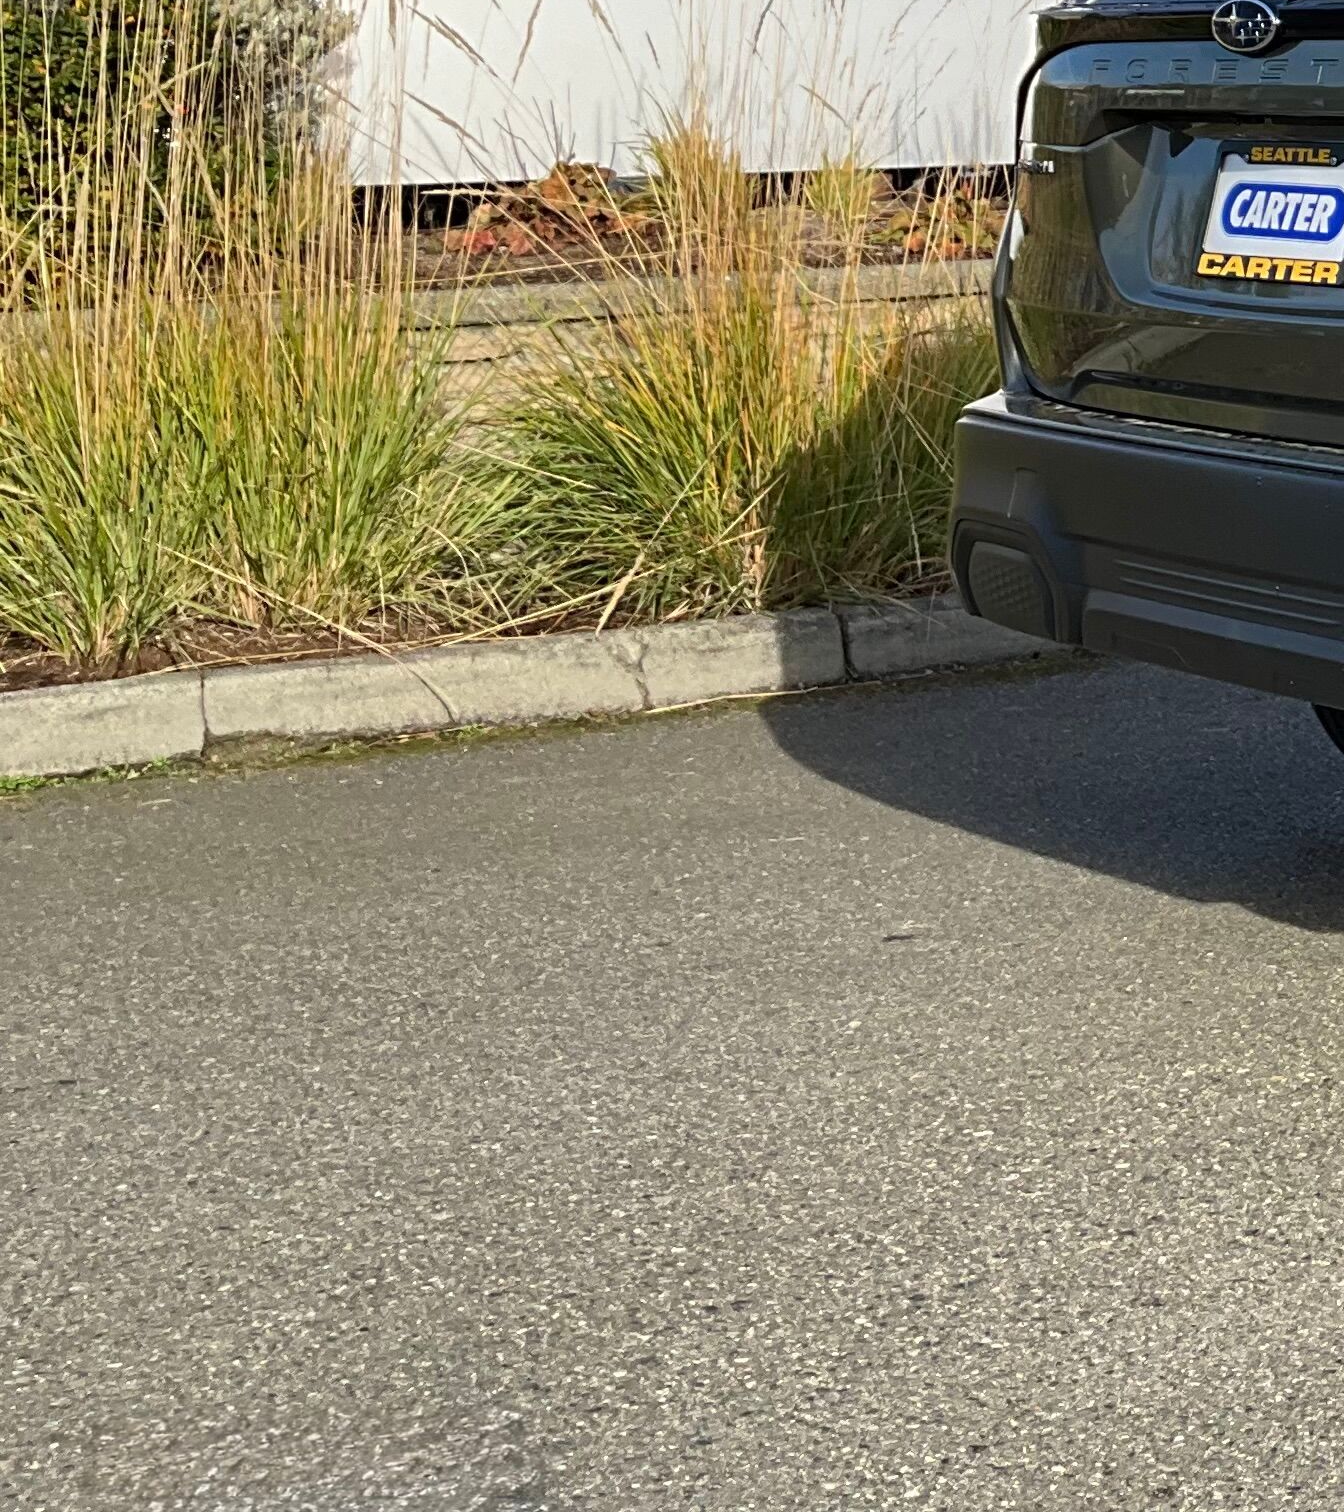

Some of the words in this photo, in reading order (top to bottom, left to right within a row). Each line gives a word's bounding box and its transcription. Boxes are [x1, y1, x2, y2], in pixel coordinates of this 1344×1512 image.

[1249, 146, 1332, 165] SEATTLE
[1229, 188, 1337, 234] CARTER
[1197, 252, 1340, 285] CARTER
